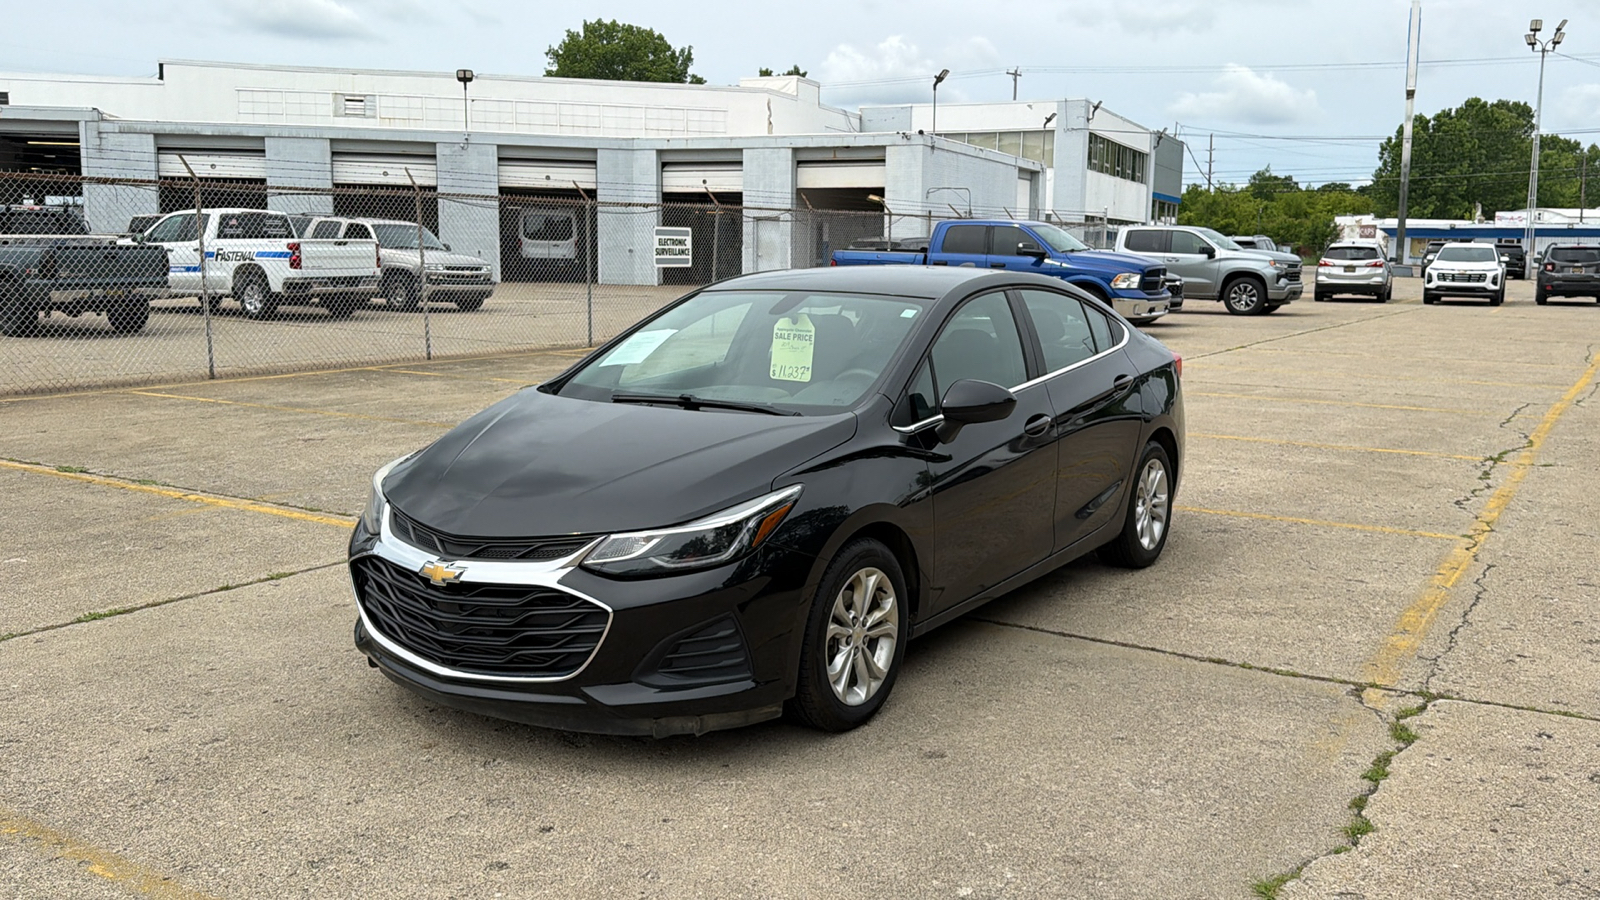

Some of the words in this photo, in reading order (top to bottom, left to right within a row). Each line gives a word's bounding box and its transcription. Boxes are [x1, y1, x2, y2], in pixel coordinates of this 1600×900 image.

[658, 238, 687, 246] ELECTRONIC
[215, 248, 255, 261] FASTENAL
[655, 248, 690, 256] SURVEILLANCE
[775, 332, 791, 340] SALE
[793, 333, 813, 342] PRICE
